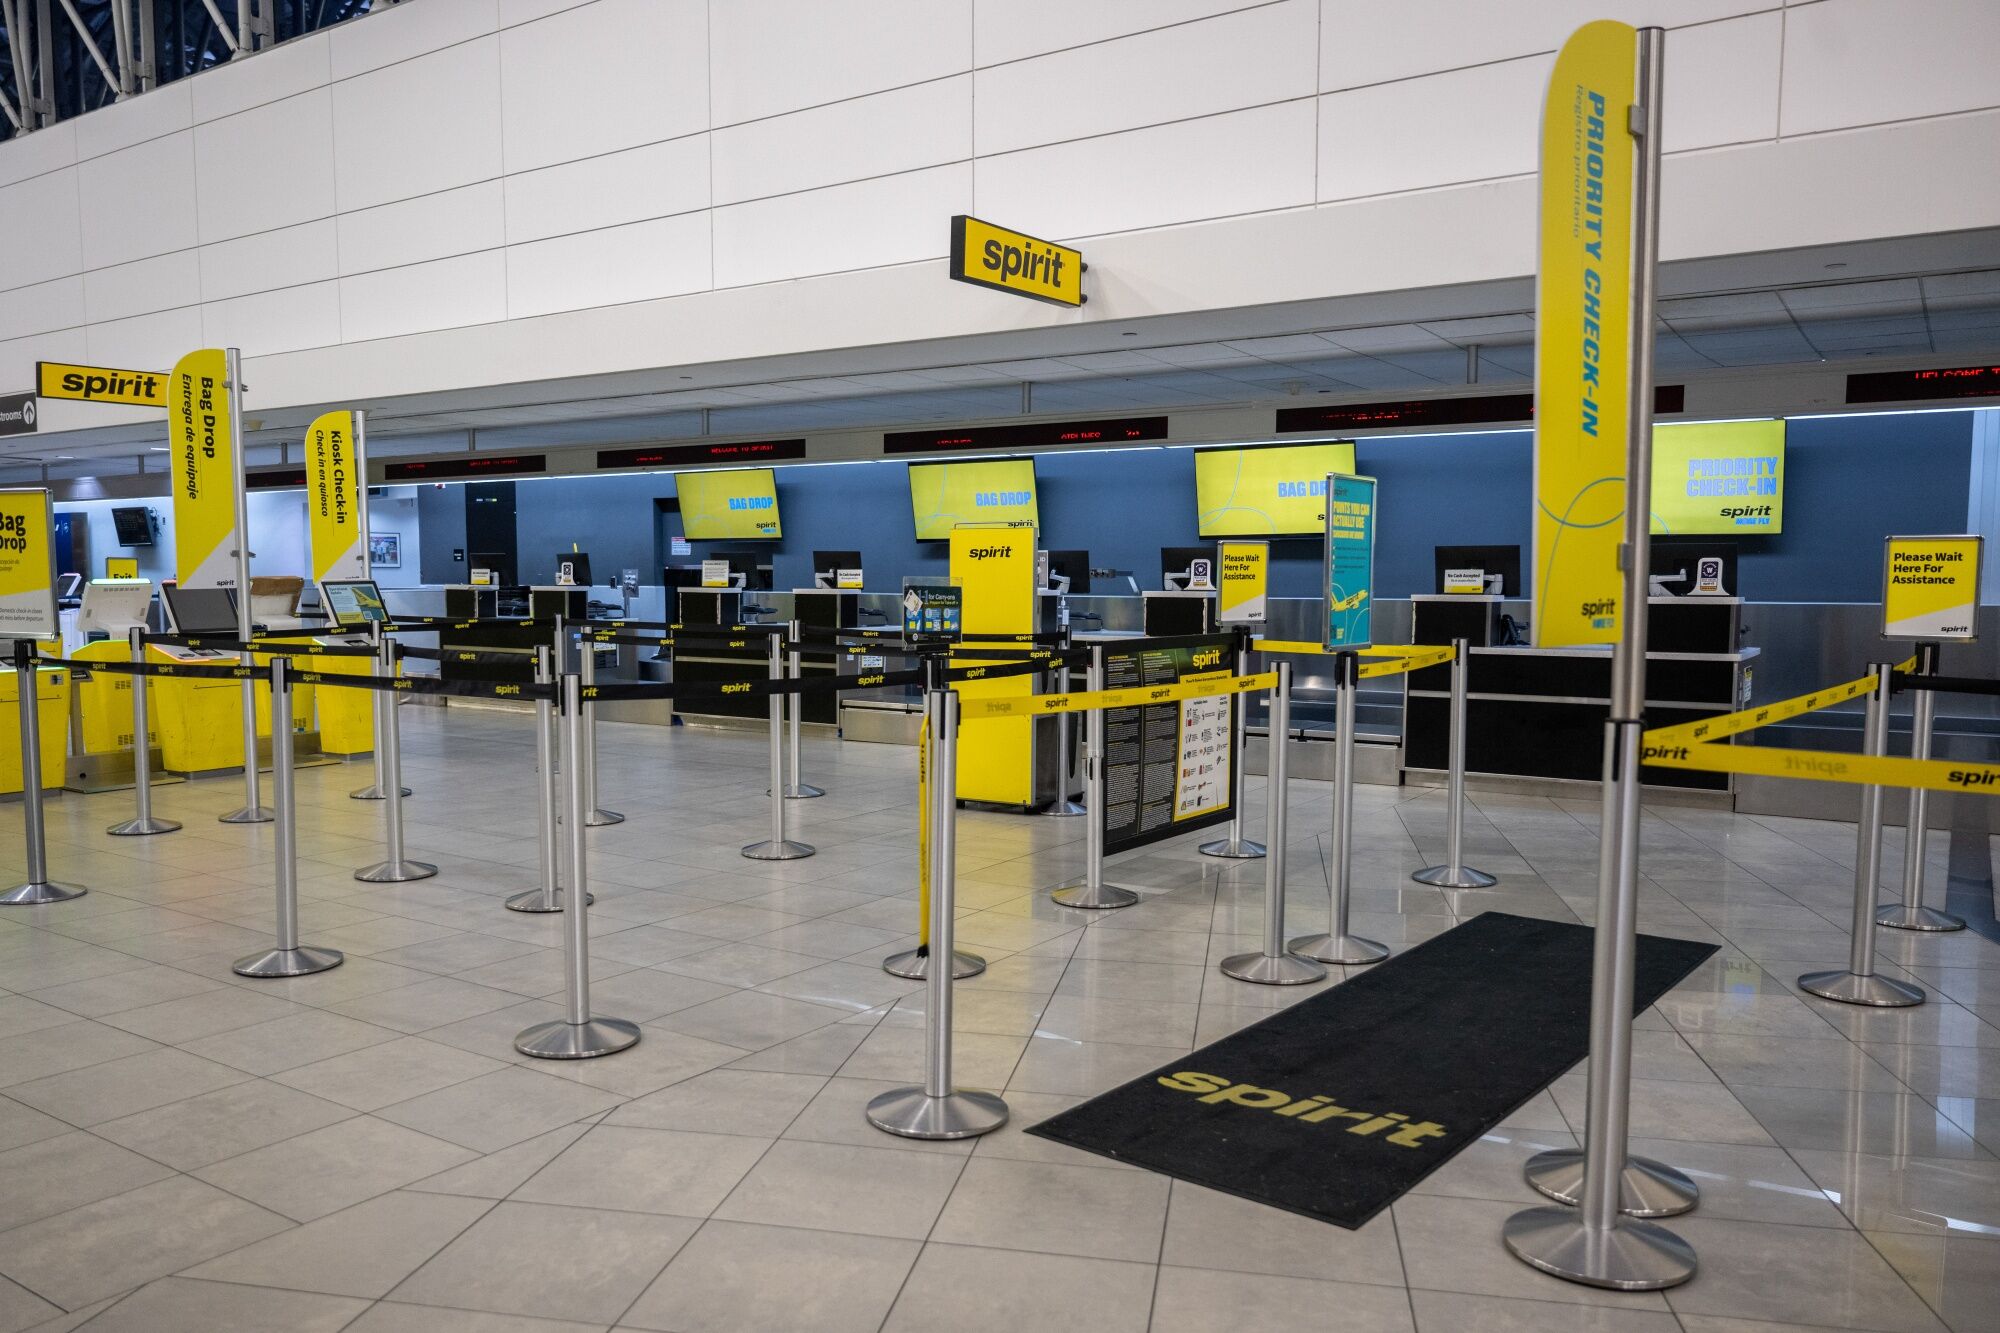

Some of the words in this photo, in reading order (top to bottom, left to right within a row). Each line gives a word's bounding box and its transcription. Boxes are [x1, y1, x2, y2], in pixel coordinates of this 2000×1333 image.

[1584, 90, 1606, 261] PRIORITY
[982, 239, 1064, 288] spirit
[1582, 269, 1601, 438] CHECK-IN
[62, 373, 158, 398] spirit
[182, 373, 192, 424] Entrega
[199, 376, 213, 411] Bag
[0, 411, 22, 422] trooms
[186, 426, 195, 442] de
[202, 415, 215, 459] Drop
[316, 429, 325, 457] Check
[331, 430, 343, 466] Kiosk
[185, 442, 198, 500] equipaje
[1688, 456, 1778, 477] PRIORITY
[1278, 481, 1306, 497] BAG
[1309, 480, 1328, 497] DR
[1686, 477, 1777, 497] CHECK-IN
[334, 469, 347, 524] Check-in
[729, 498, 747, 511] BAG
[749, 496, 773, 510] DROP
[976, 492, 998, 506] BAG
[1000, 491, 1032, 506] DROP
[1720, 505, 1771, 518] spirit
[756, 521, 776, 529] spirit
[969, 546, 1012, 561] spirit
[1224, 554, 1244, 562] Please
[1245, 554, 1259, 562] Wait
[1894, 552, 1933, 562] Please
[1935, 552, 1963, 562] Wait
[1893, 564, 1922, 573] Here
[1923, 564, 1943, 573] For
[1223, 573, 1256, 581] Assistance
[1892, 575, 1955, 585] Assistance
[1581, 598, 1616, 619] spirit
[1940, 625, 1969, 633] spirit
[1030, 651, 1051, 659] spirit
[1192, 649, 1220, 669] spirit
[1049, 657, 1063, 669] spirit
[303, 673, 321, 682] spirit
[858, 674, 884, 685] spirit
[967, 667, 986, 679] spirit
[394, 680, 413, 689] spirit
[496, 684, 519, 695] spirit
[721, 682, 751, 693] spirit
[1239, 678, 1256, 689] spirit
[583, 687, 599, 697] rit
[1151, 688, 1170, 700] spirit
[1045, 698, 1069, 709] spirit
[1642, 745, 1690, 760] pirit
[1947, 769, 2000, 787] spir
[1157, 1071, 1447, 1148] spirit
